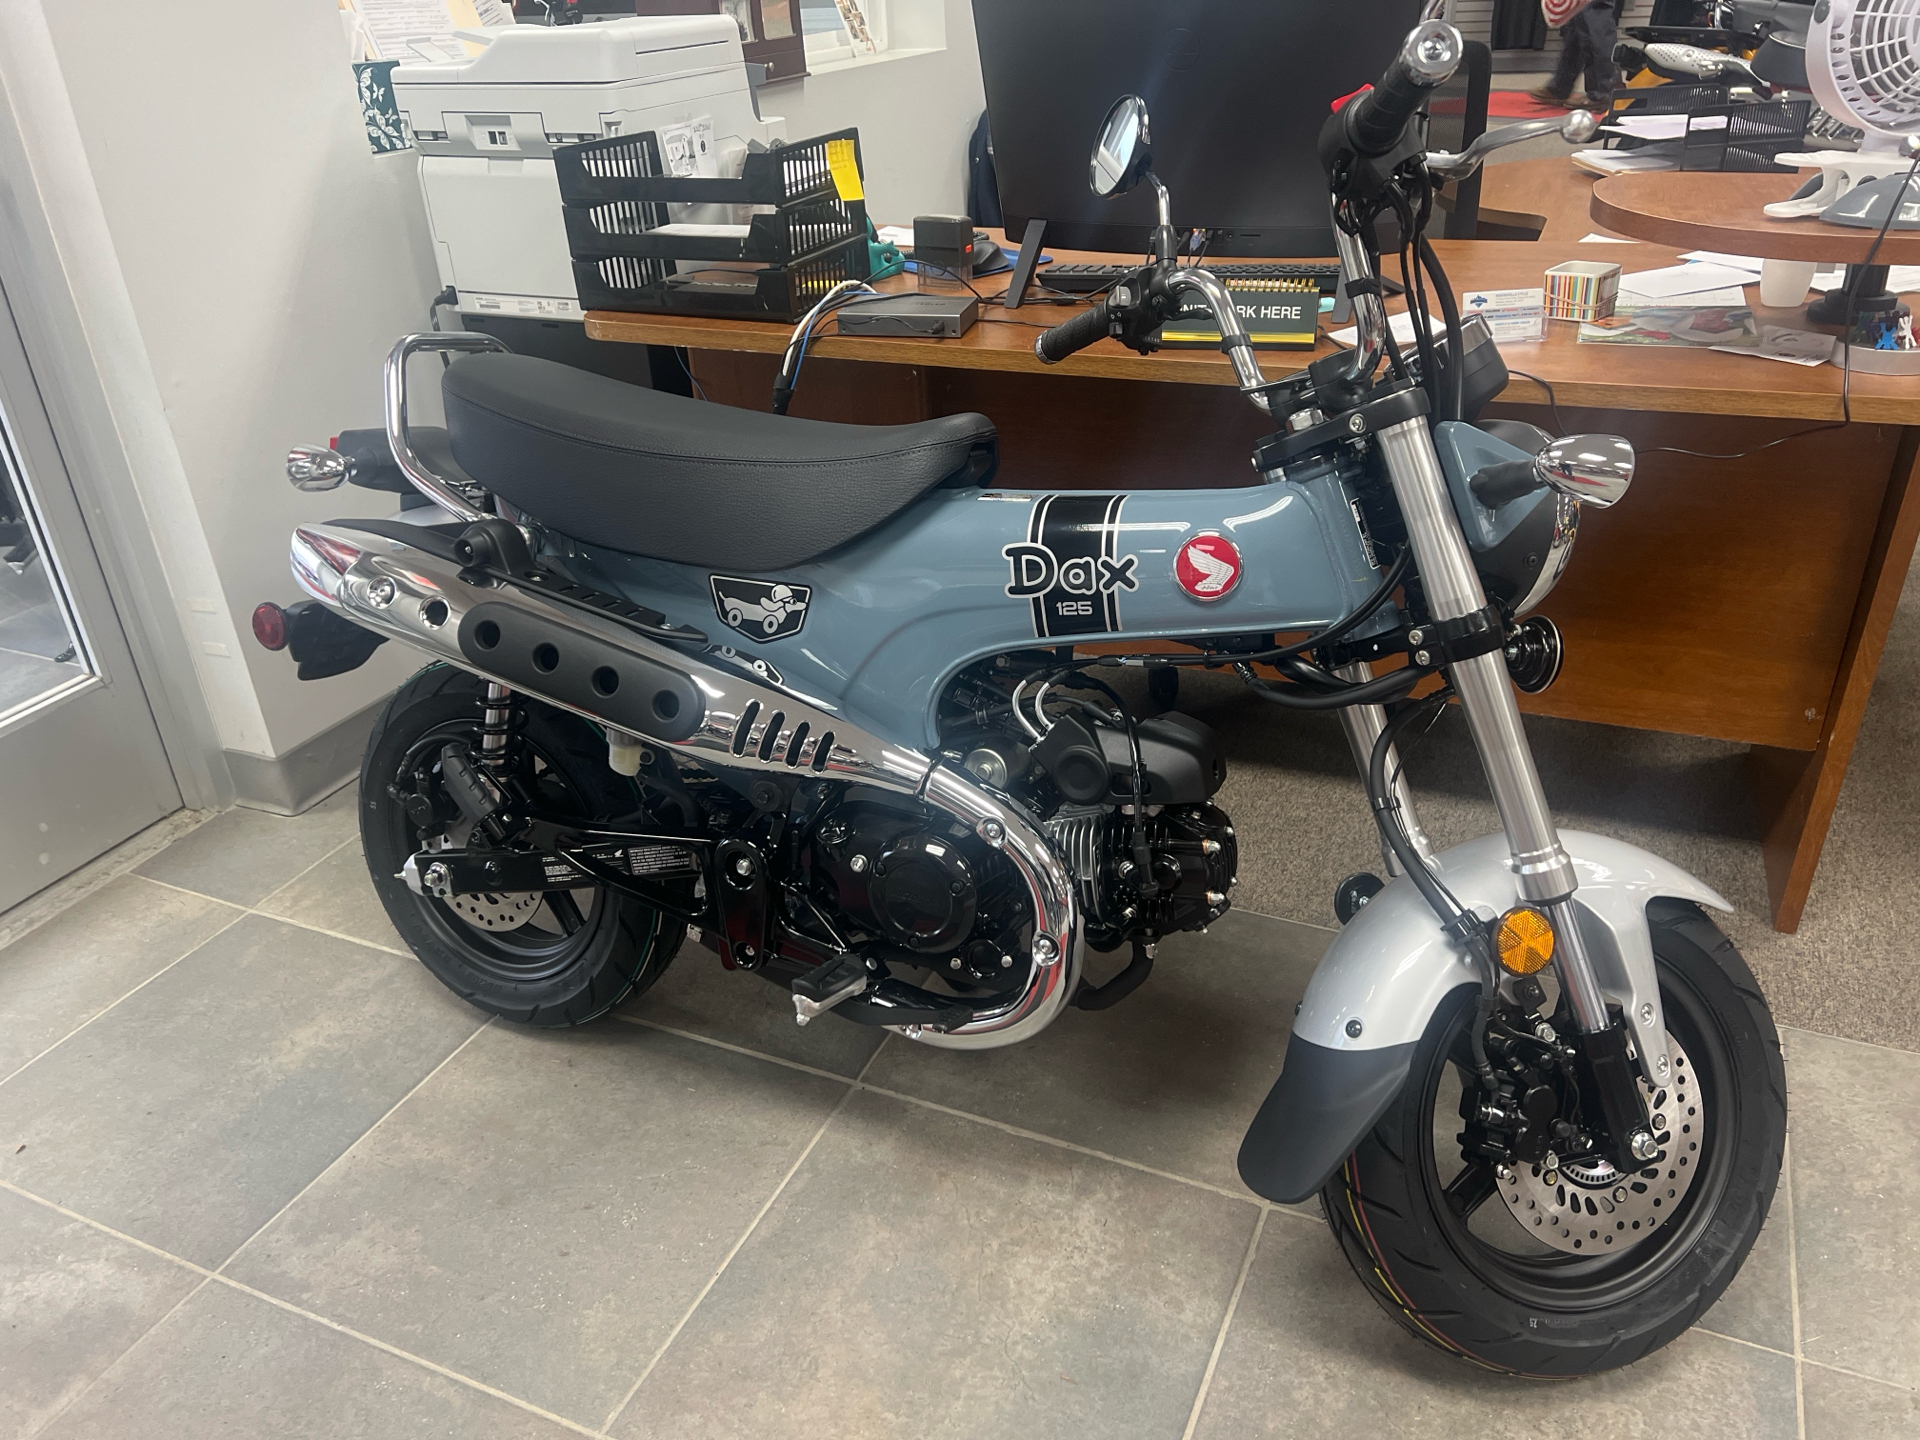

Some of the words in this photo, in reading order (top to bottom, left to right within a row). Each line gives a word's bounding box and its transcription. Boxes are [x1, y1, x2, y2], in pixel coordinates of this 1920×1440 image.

[1261, 306, 1301, 319] HERE
[1001, 542, 1139, 599] Dax
[1056, 601, 1093, 615] 125
